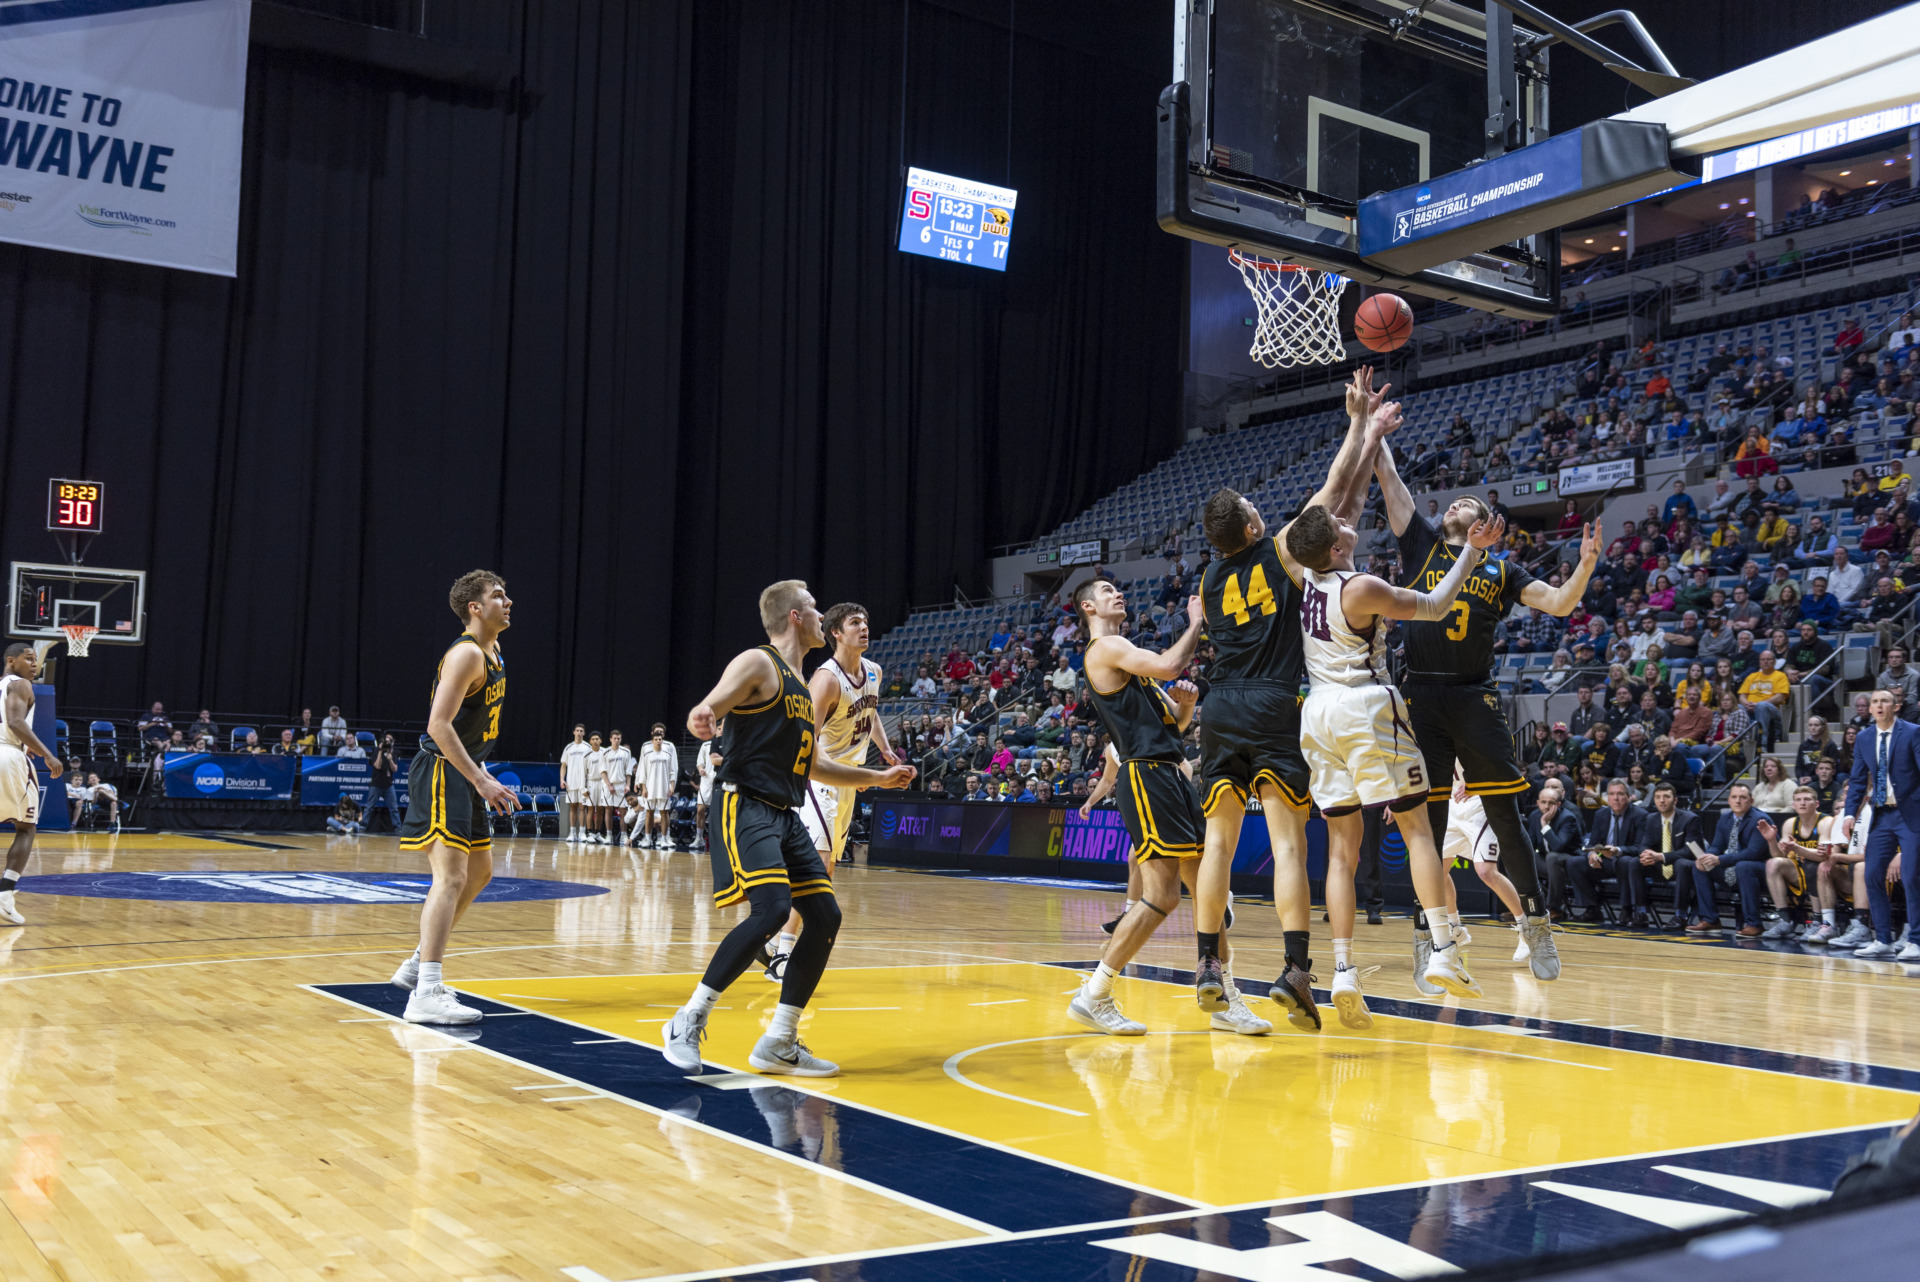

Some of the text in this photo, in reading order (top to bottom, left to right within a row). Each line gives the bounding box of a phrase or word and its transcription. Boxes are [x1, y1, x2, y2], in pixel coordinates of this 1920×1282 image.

[81, 91, 122, 128] TO
[0, 116, 174, 193] WAYNE
[921, 177, 1014, 204] BASKETBALL CHAMPIONSHIP
[1413, 172, 1544, 226] BASKETBALL CHAMPIONSHIP
[1417, 194, 1431, 203] NCAA
[78, 203, 176, 229] VisitFortWayne.com
[940, 198, 974, 219] 13:23
[920, 225, 931, 243] 6
[950, 219, 975, 234] 1 HALF
[982, 222, 1010, 237] UWO
[944, 235, 974, 250] 1 FLS 0
[993, 240, 1009, 259] 17
[940, 247, 973, 263] 3 TOL 4
[1597, 461, 1632, 473] WELCOME TO
[60, 485, 98, 501] 13:23
[1515, 484, 1530, 495] 218
[59, 500, 93, 526] 30
[1222, 563, 1277, 626] 44
[1426, 570, 1500, 605] OSKOSH
[1446, 599, 1470, 641] 3
[850, 715, 872, 746] 24
[793, 730, 814, 776] 2
[196, 777, 224, 786] NCAA
[225, 777, 257, 787] Division
[1407, 766, 1423, 787] S
[522, 785, 549, 793] Division
[898, 816, 961, 838] AT&T NCAA
[1488, 843, 1498, 856] S
